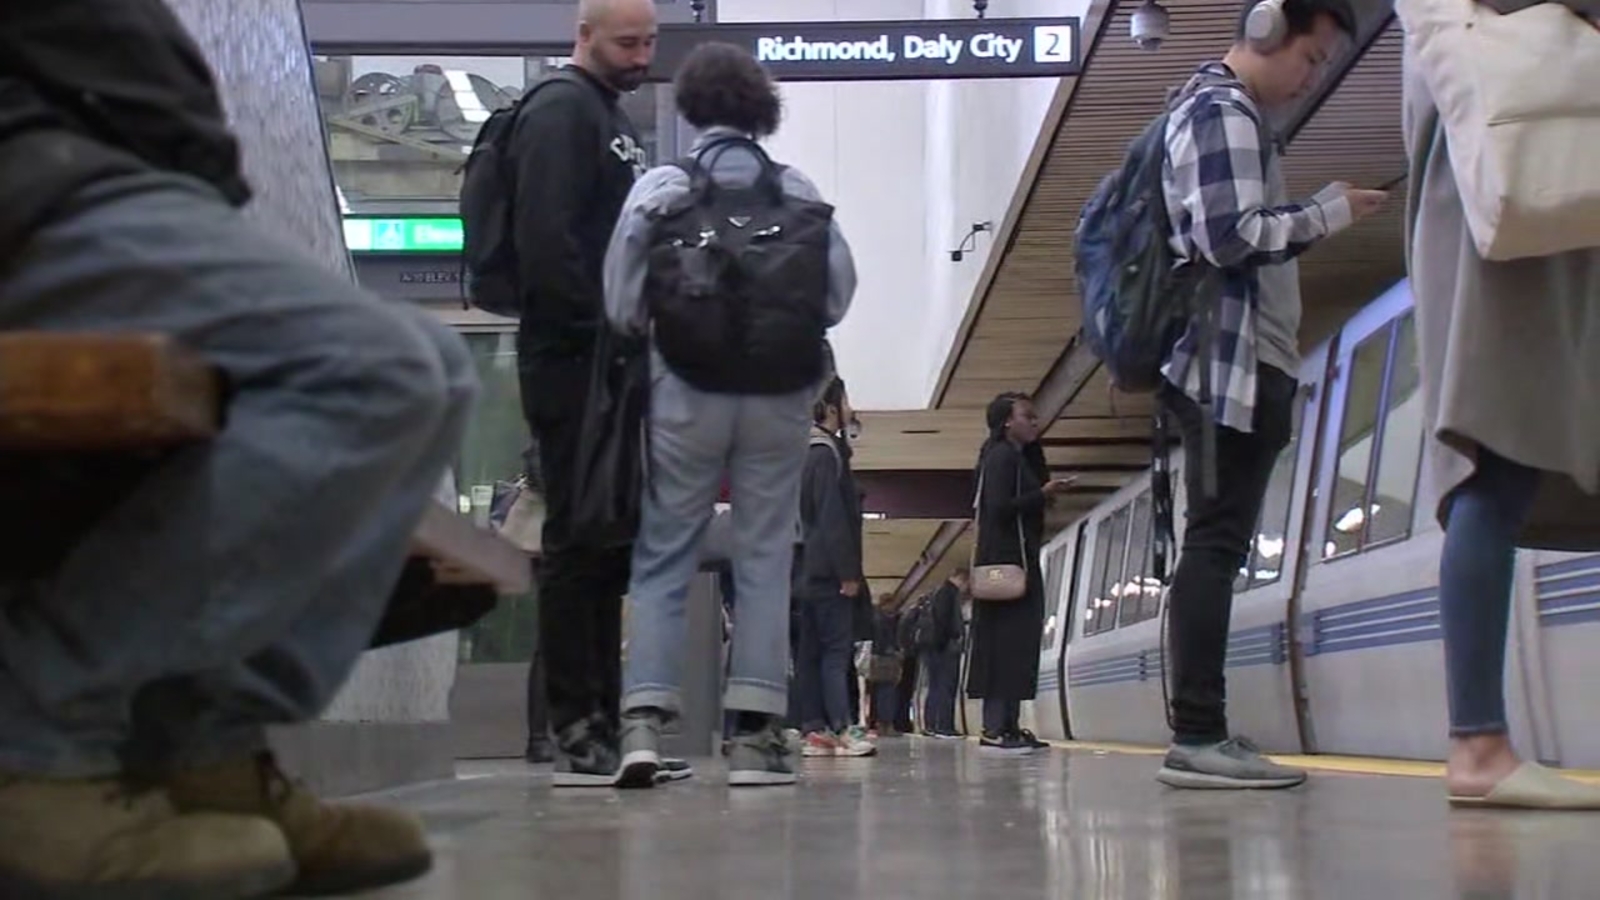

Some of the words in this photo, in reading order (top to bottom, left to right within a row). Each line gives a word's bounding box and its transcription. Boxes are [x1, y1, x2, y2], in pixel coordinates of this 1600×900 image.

[757, 35, 895, 62] Richmond,
[903, 34, 963, 63] Daly
[969, 33, 1023, 63] City
[1043, 32, 1061, 57] 2
